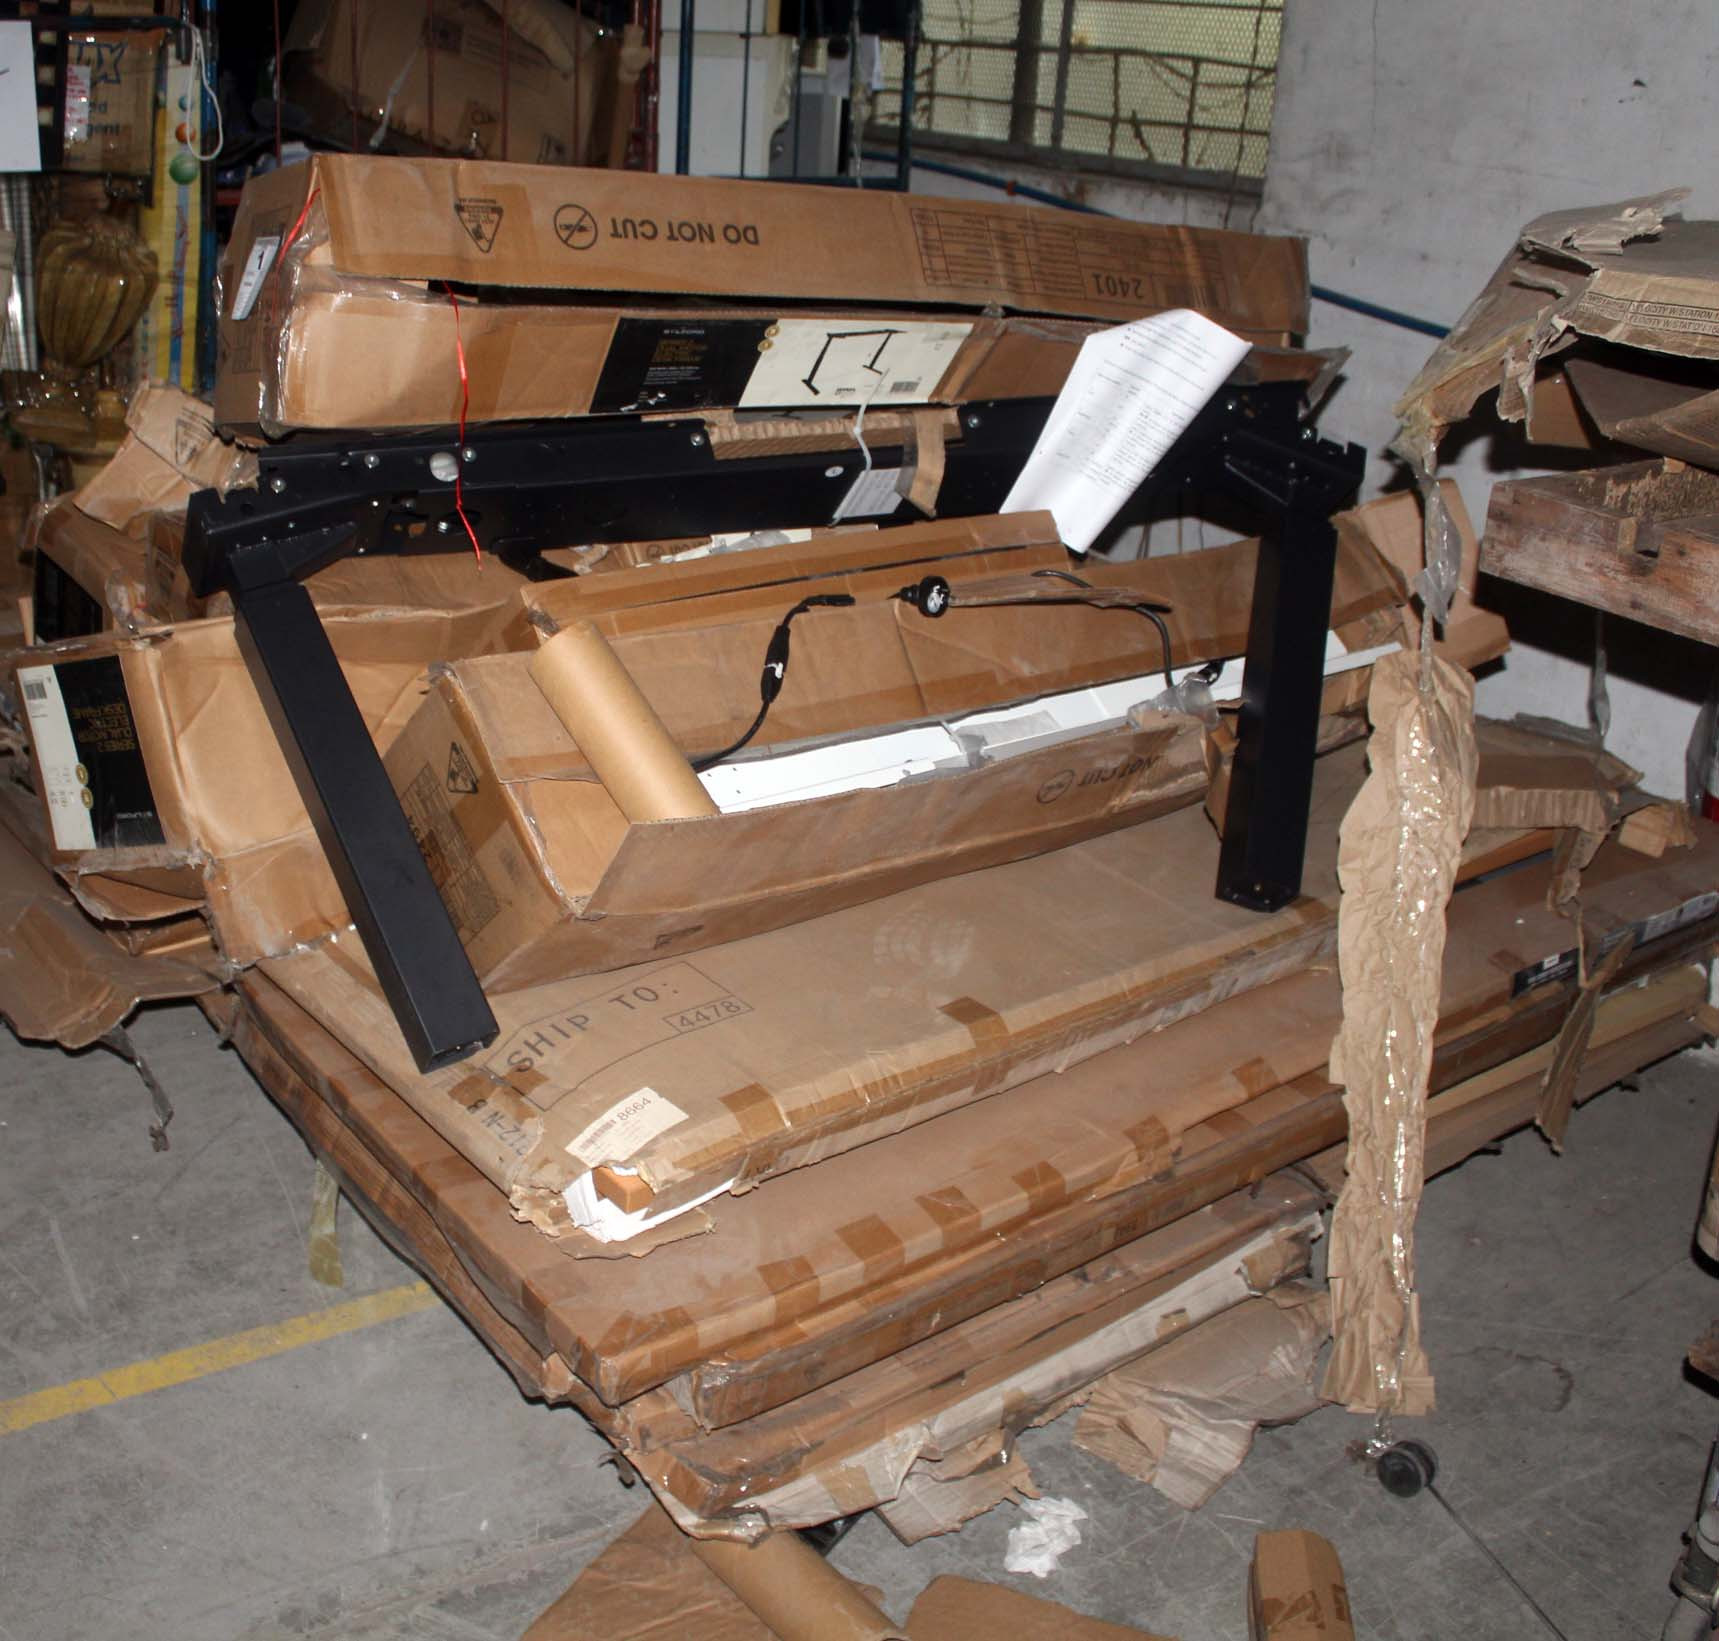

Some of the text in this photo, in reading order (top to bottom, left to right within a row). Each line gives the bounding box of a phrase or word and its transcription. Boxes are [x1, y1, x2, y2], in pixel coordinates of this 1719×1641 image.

[609, 217, 759, 247] DO NOT CUT
[1090, 272, 1144, 301] 2401
[677, 999, 742, 1030] 4478
[506, 1013, 593, 1074] SHIP
[616, 1095, 653, 1122] 8664
